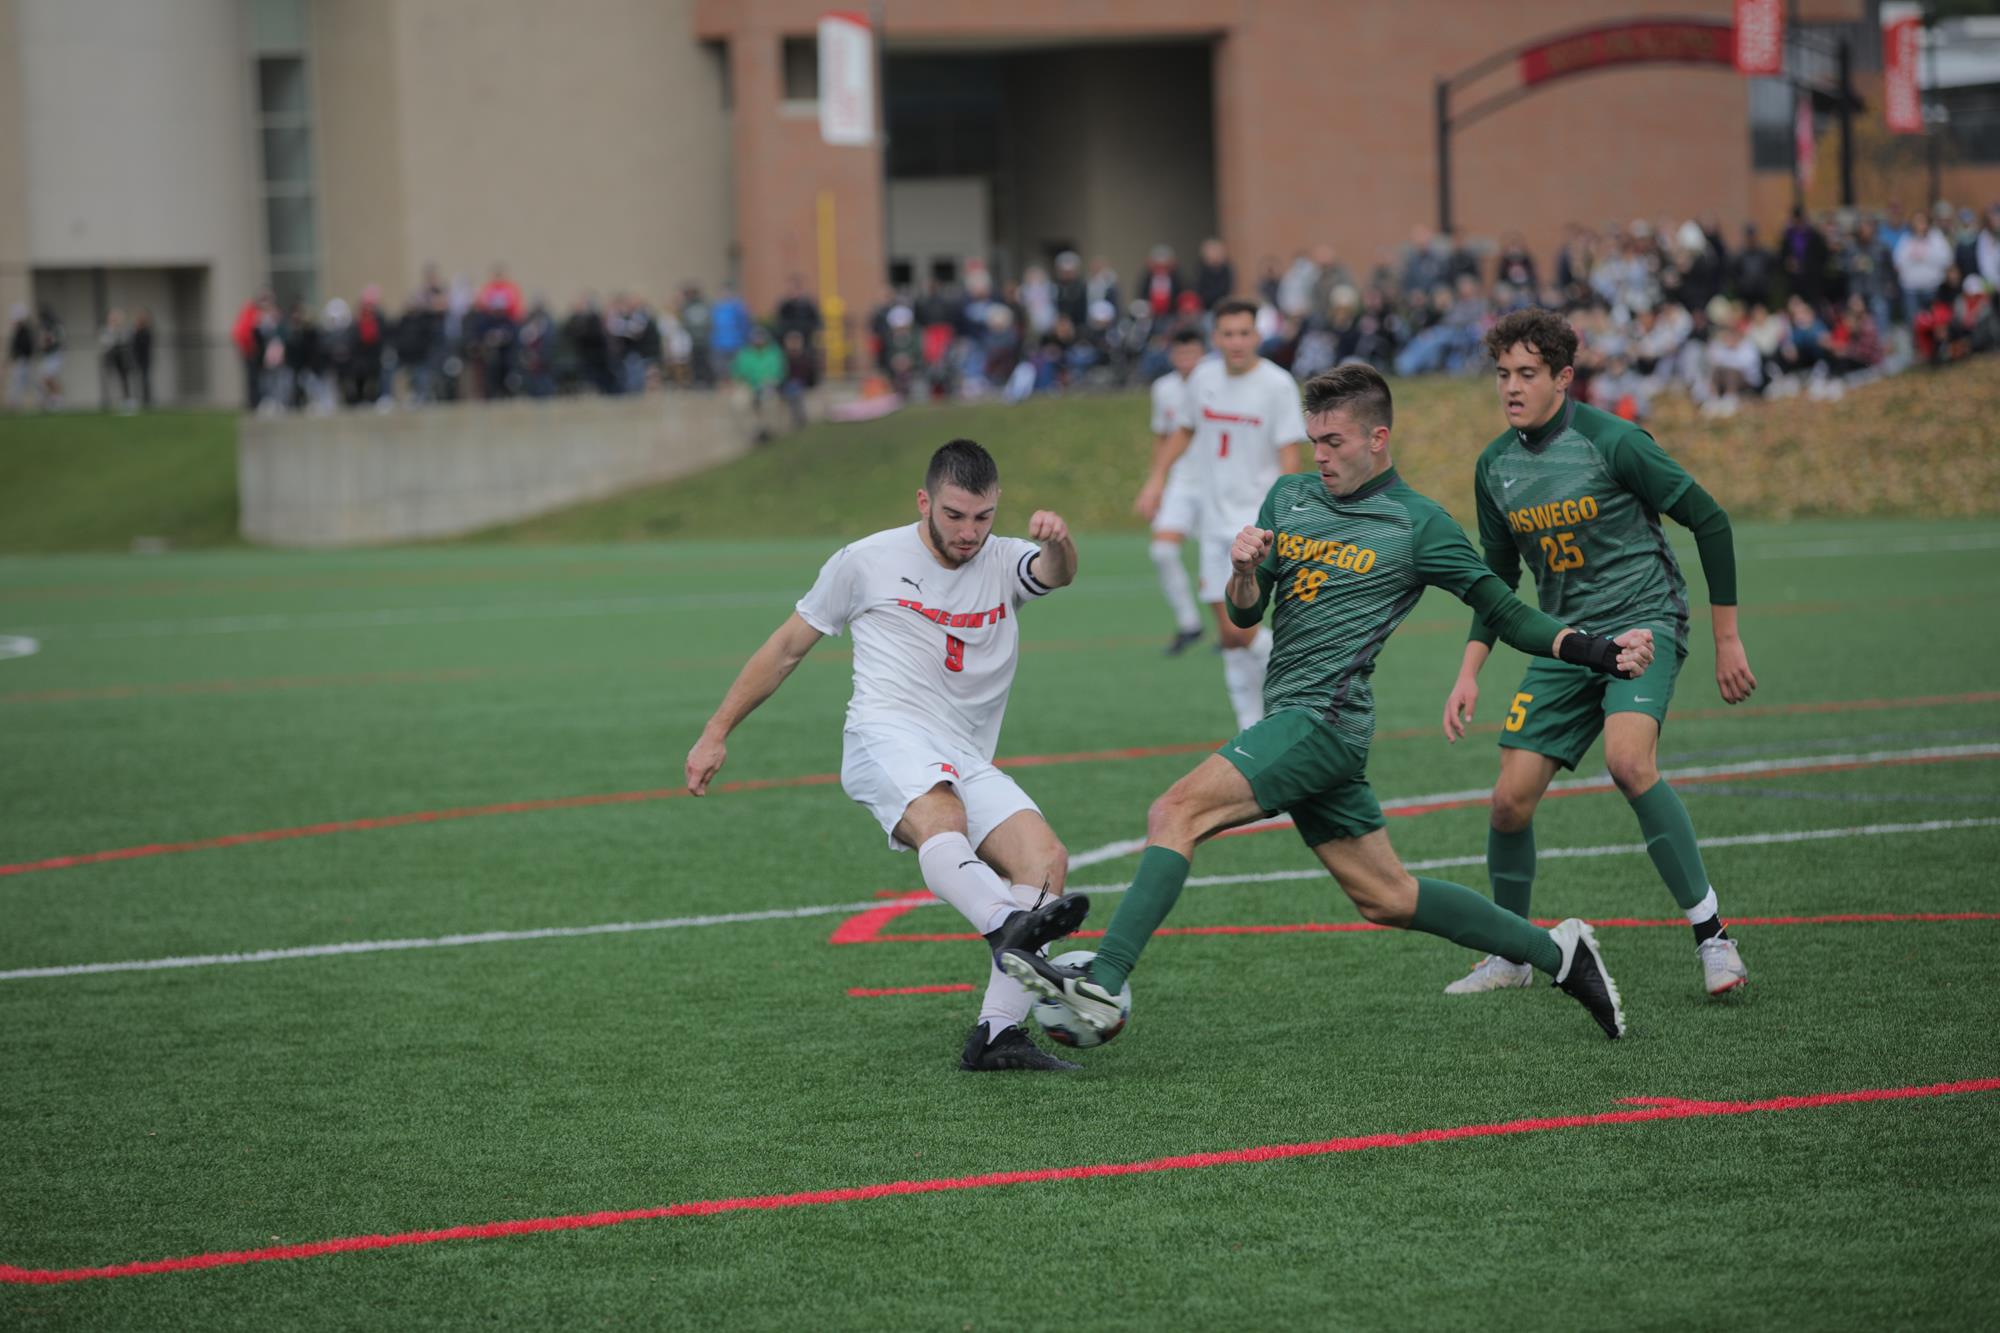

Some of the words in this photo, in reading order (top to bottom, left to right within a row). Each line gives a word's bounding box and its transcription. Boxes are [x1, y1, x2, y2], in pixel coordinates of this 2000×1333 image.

[1508, 496, 1598, 533] OSWEGO
[1277, 532, 1377, 574] OSWEGO
[1540, 532, 1585, 573] 25
[945, 633, 965, 672] 9
[1505, 692, 1533, 732] 5
